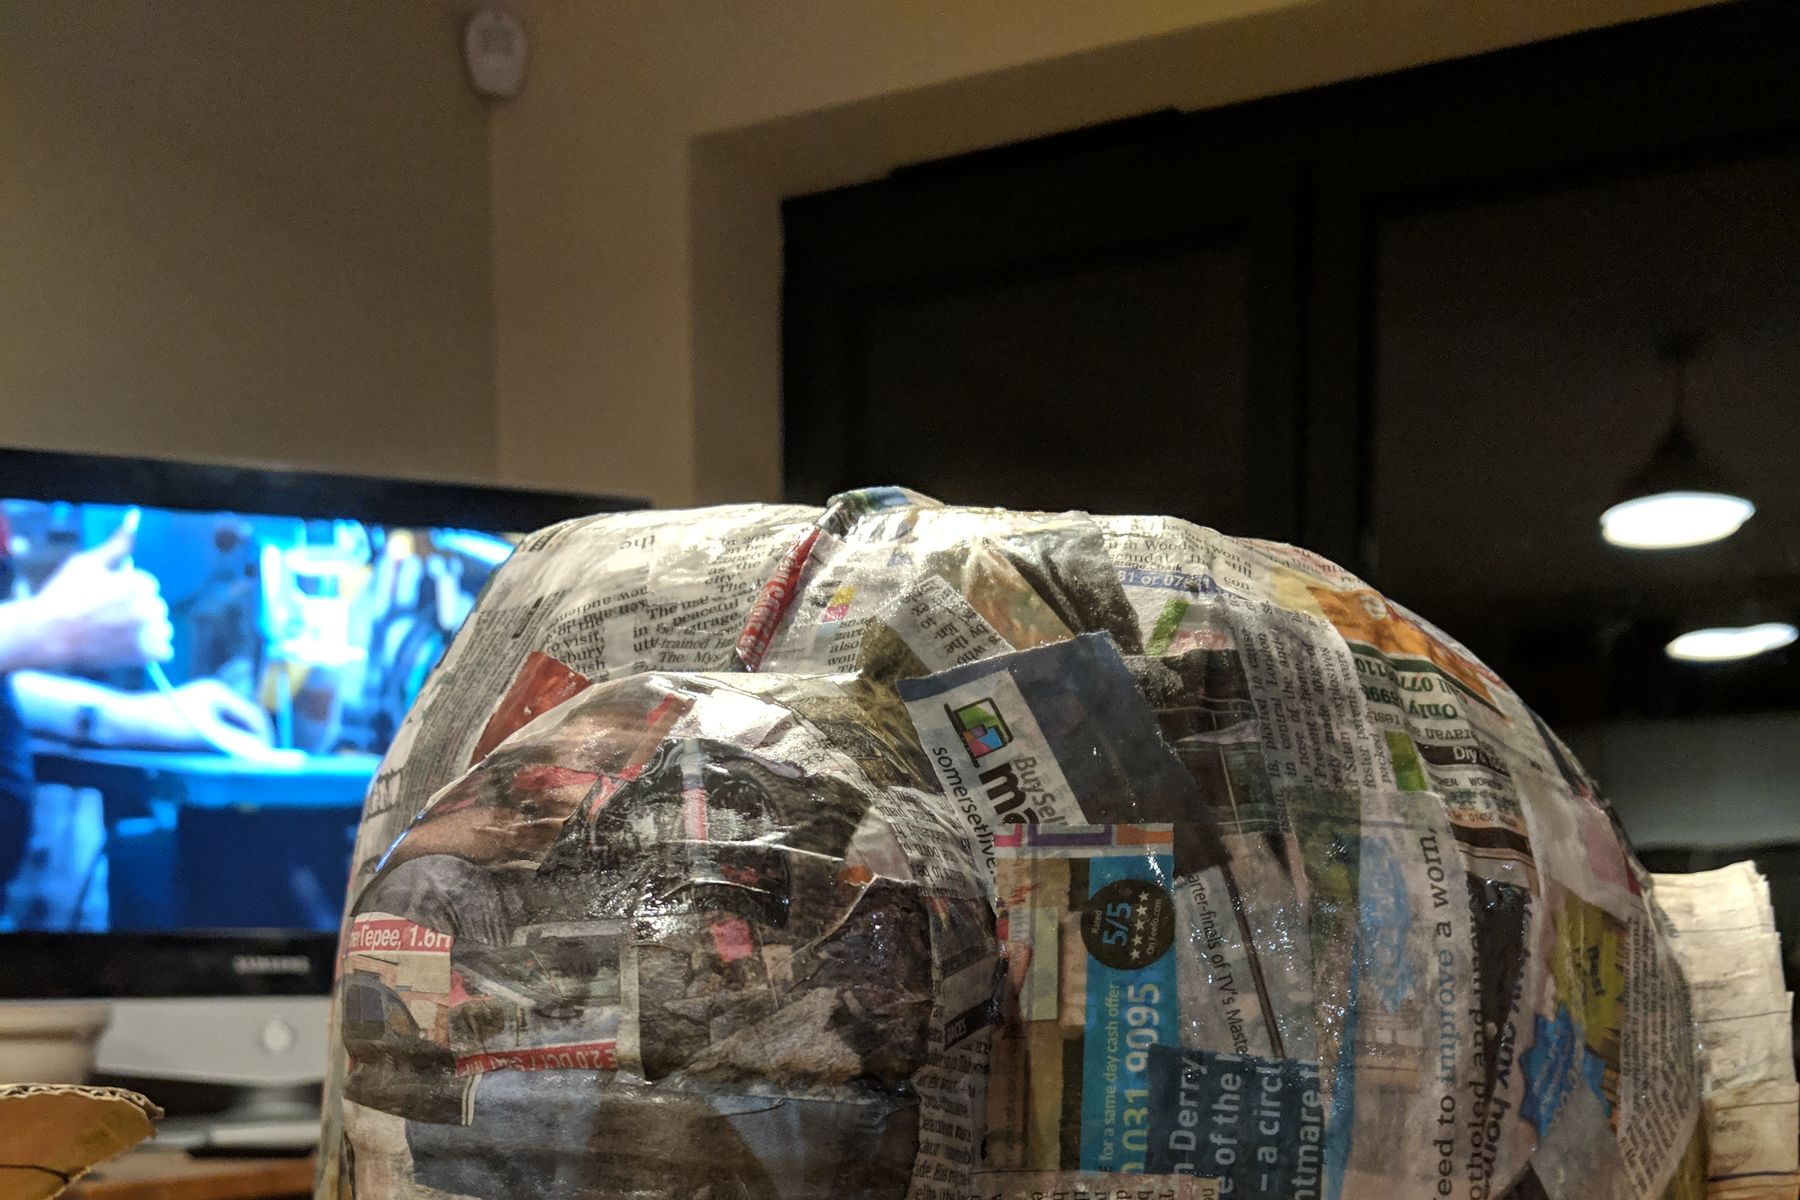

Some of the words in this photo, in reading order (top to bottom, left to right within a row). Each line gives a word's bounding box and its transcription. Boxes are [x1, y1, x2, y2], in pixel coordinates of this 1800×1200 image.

[943, 633, 970, 655] the
[1408, 700, 1458, 721] Only
[1453, 746, 1479, 765] Diy
[1102, 901, 1135, 947] 5/5
[1433, 919, 1453, 940] a
[1436, 948, 1458, 1085] improve
[1104, 1023, 1119, 1053] cash
[1104, 1084, 1118, 1126] same
[1169, 1056, 1208, 1150] Derry
[1211, 1071, 1243, 1126] the
[1438, 1093, 1457, 1127] to
[1099, 1139, 1115, 1163] for
[1210, 1132, 1238, 1166] of
[1257, 1146, 1279, 1165] a
